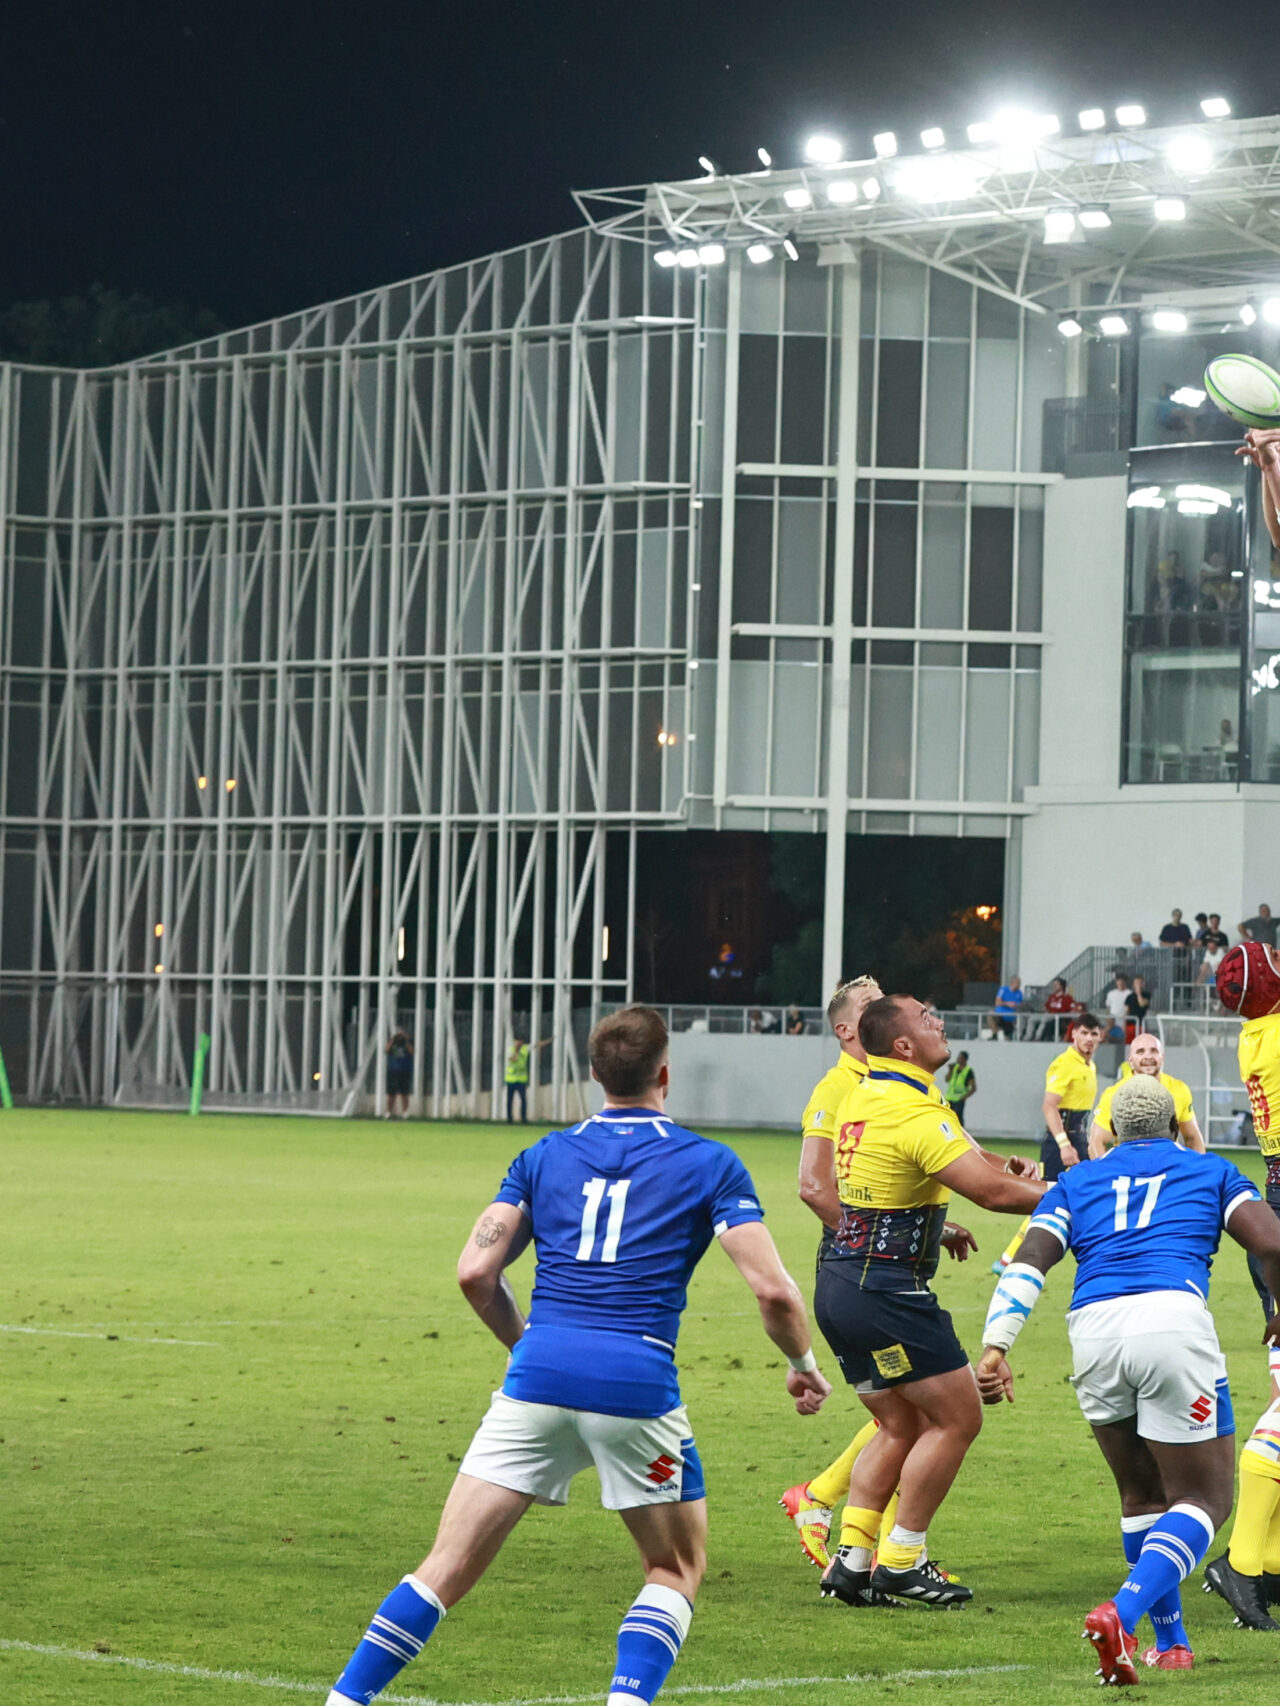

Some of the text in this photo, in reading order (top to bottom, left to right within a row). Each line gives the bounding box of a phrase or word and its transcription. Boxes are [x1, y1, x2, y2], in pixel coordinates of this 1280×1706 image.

[575, 1177, 632, 1263] 11
[1112, 1173, 1167, 1232] 17
[1120, 1581, 1141, 1594] ALIA
[611, 1675, 641, 1690] TALIA
